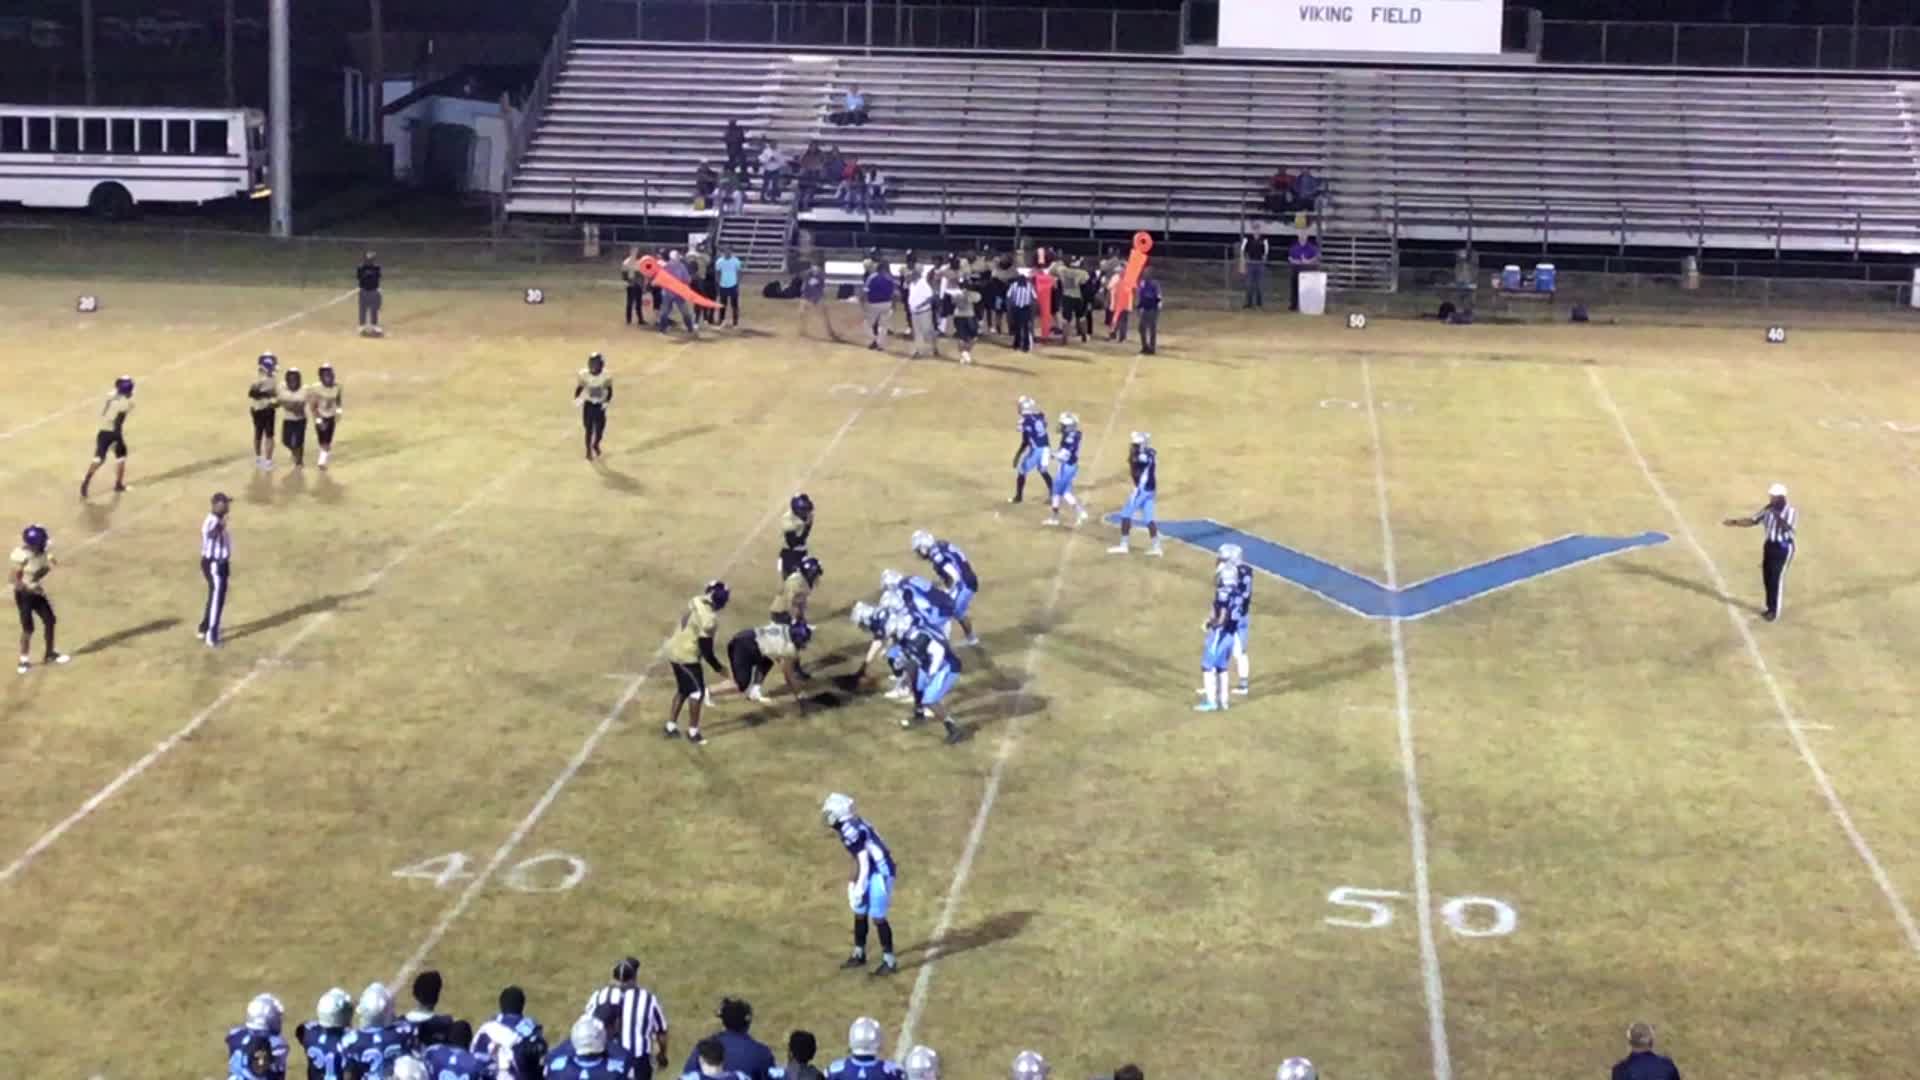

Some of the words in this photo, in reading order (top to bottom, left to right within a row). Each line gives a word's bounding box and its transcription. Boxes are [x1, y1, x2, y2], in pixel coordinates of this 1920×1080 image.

[1300, 6, 1353, 22] VIKING
[1371, 7, 1421, 24] FIELD
[1350, 313, 1365, 329] 50
[1768, 327, 1785, 341] 40
[392, 852, 588, 893] 40
[1324, 882, 1518, 937] 50
